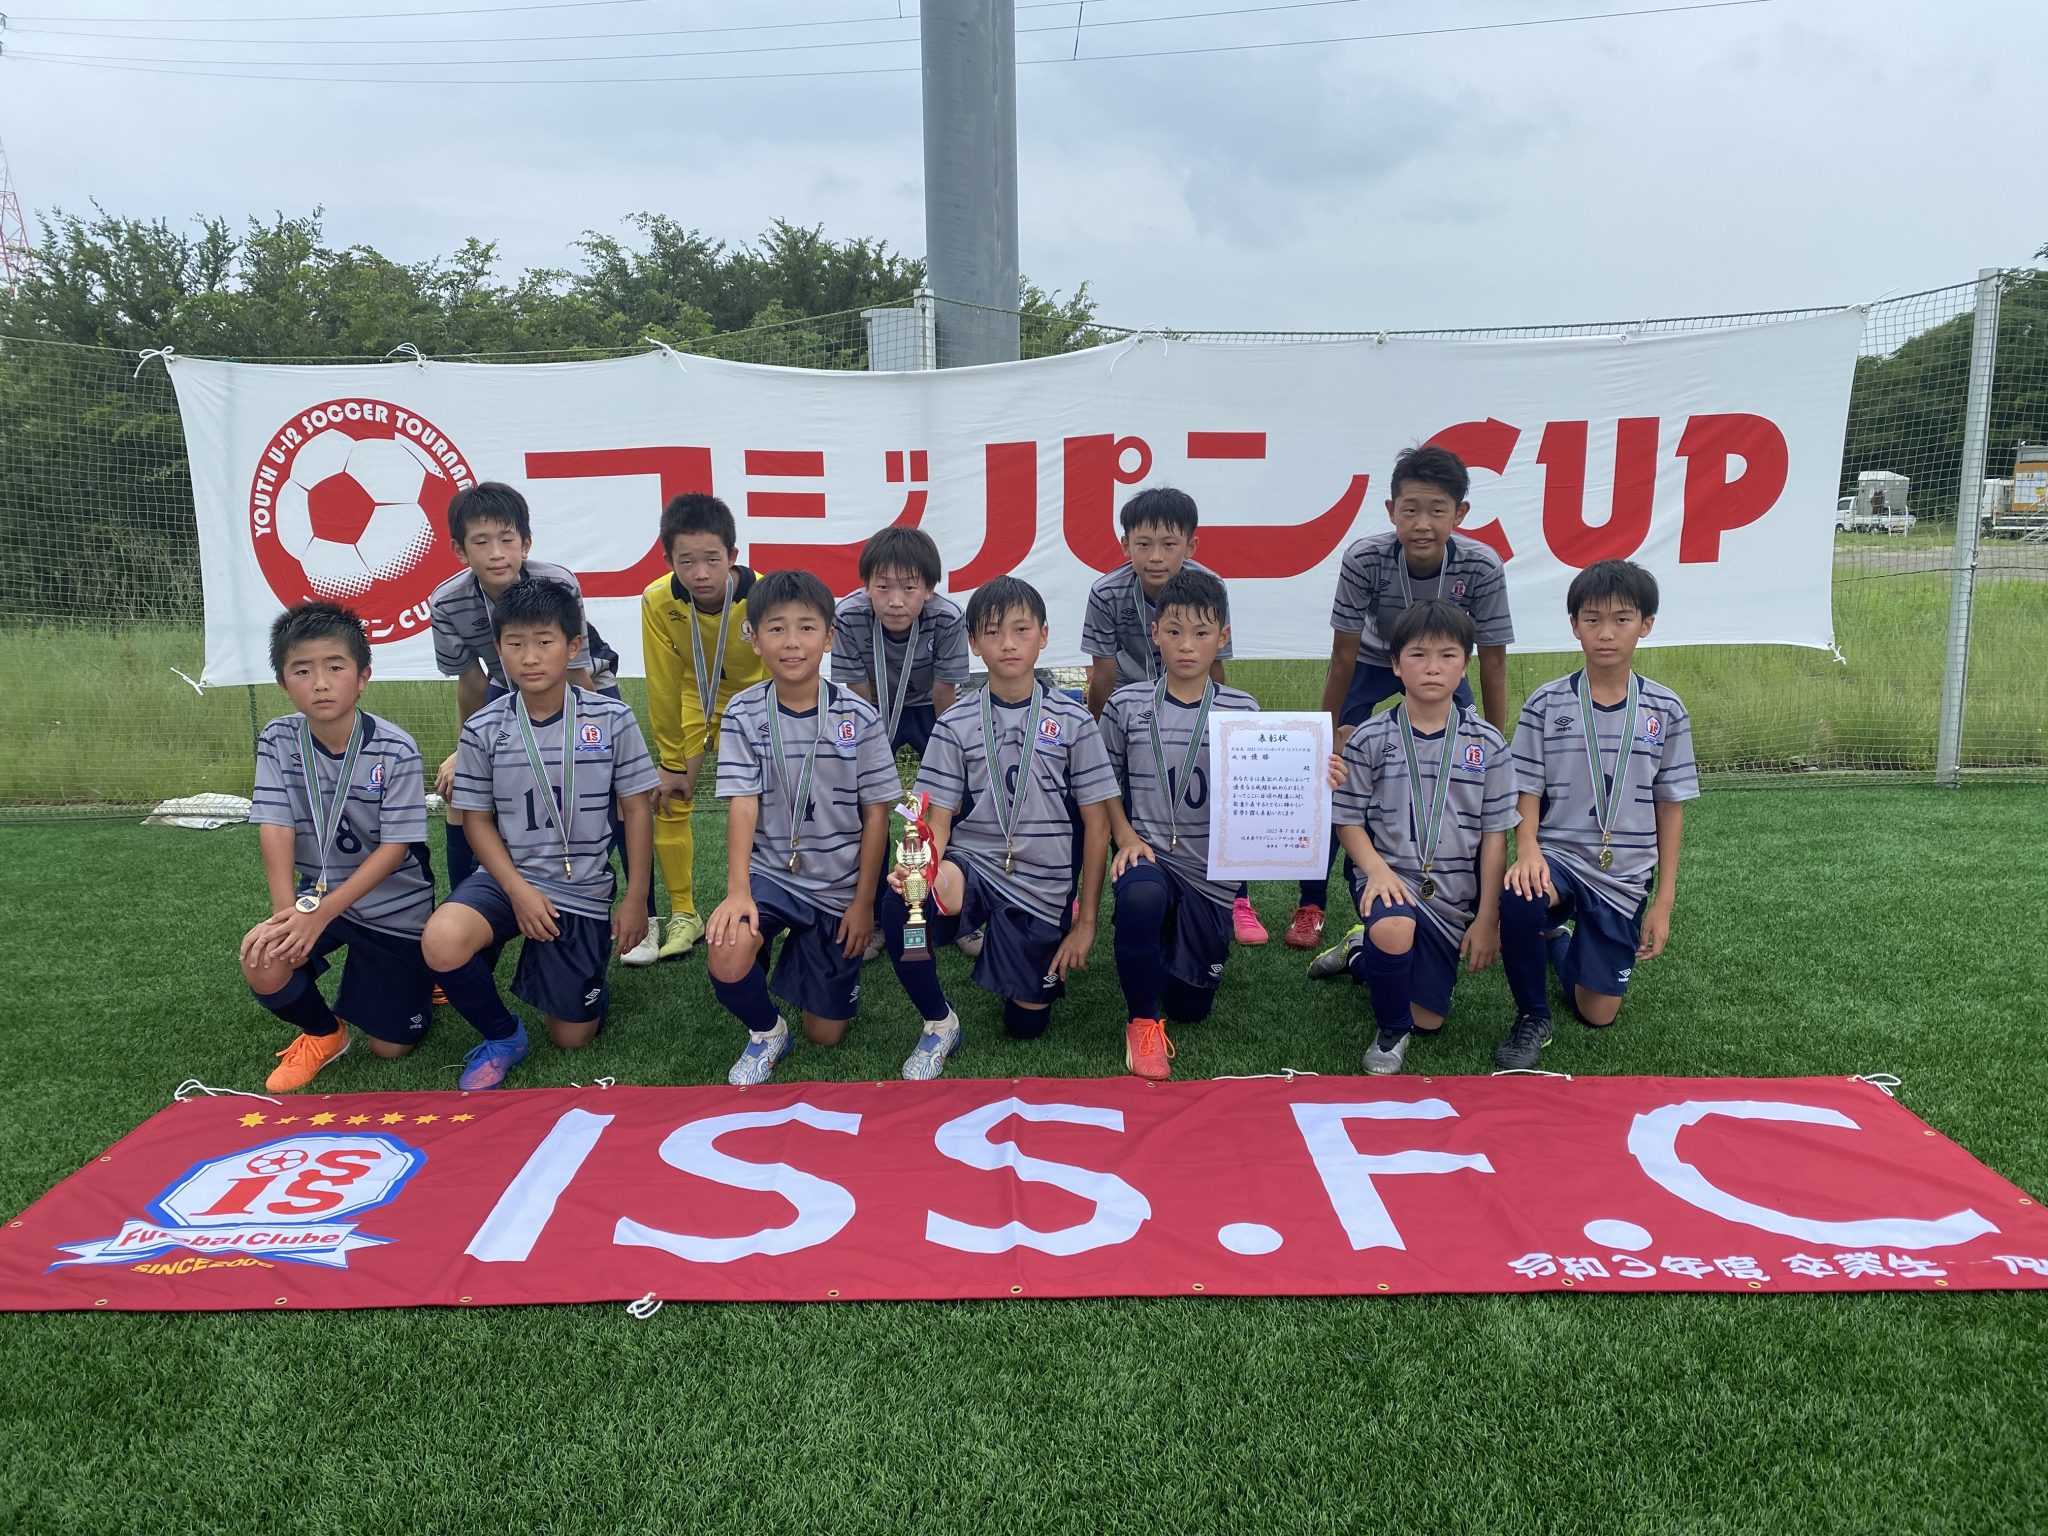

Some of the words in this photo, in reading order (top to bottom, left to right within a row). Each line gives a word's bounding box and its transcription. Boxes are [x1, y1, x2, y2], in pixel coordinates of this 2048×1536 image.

[253, 465, 278, 538] YOUTH
[268, 427, 302, 465] U-12
[301, 402, 389, 434] SOCCER
[399, 596, 434, 629] CU
[1258, 733, 1288, 743] 表彰状
[335, 814, 363, 855] 8
[246, 1232, 340, 1246] Clube
